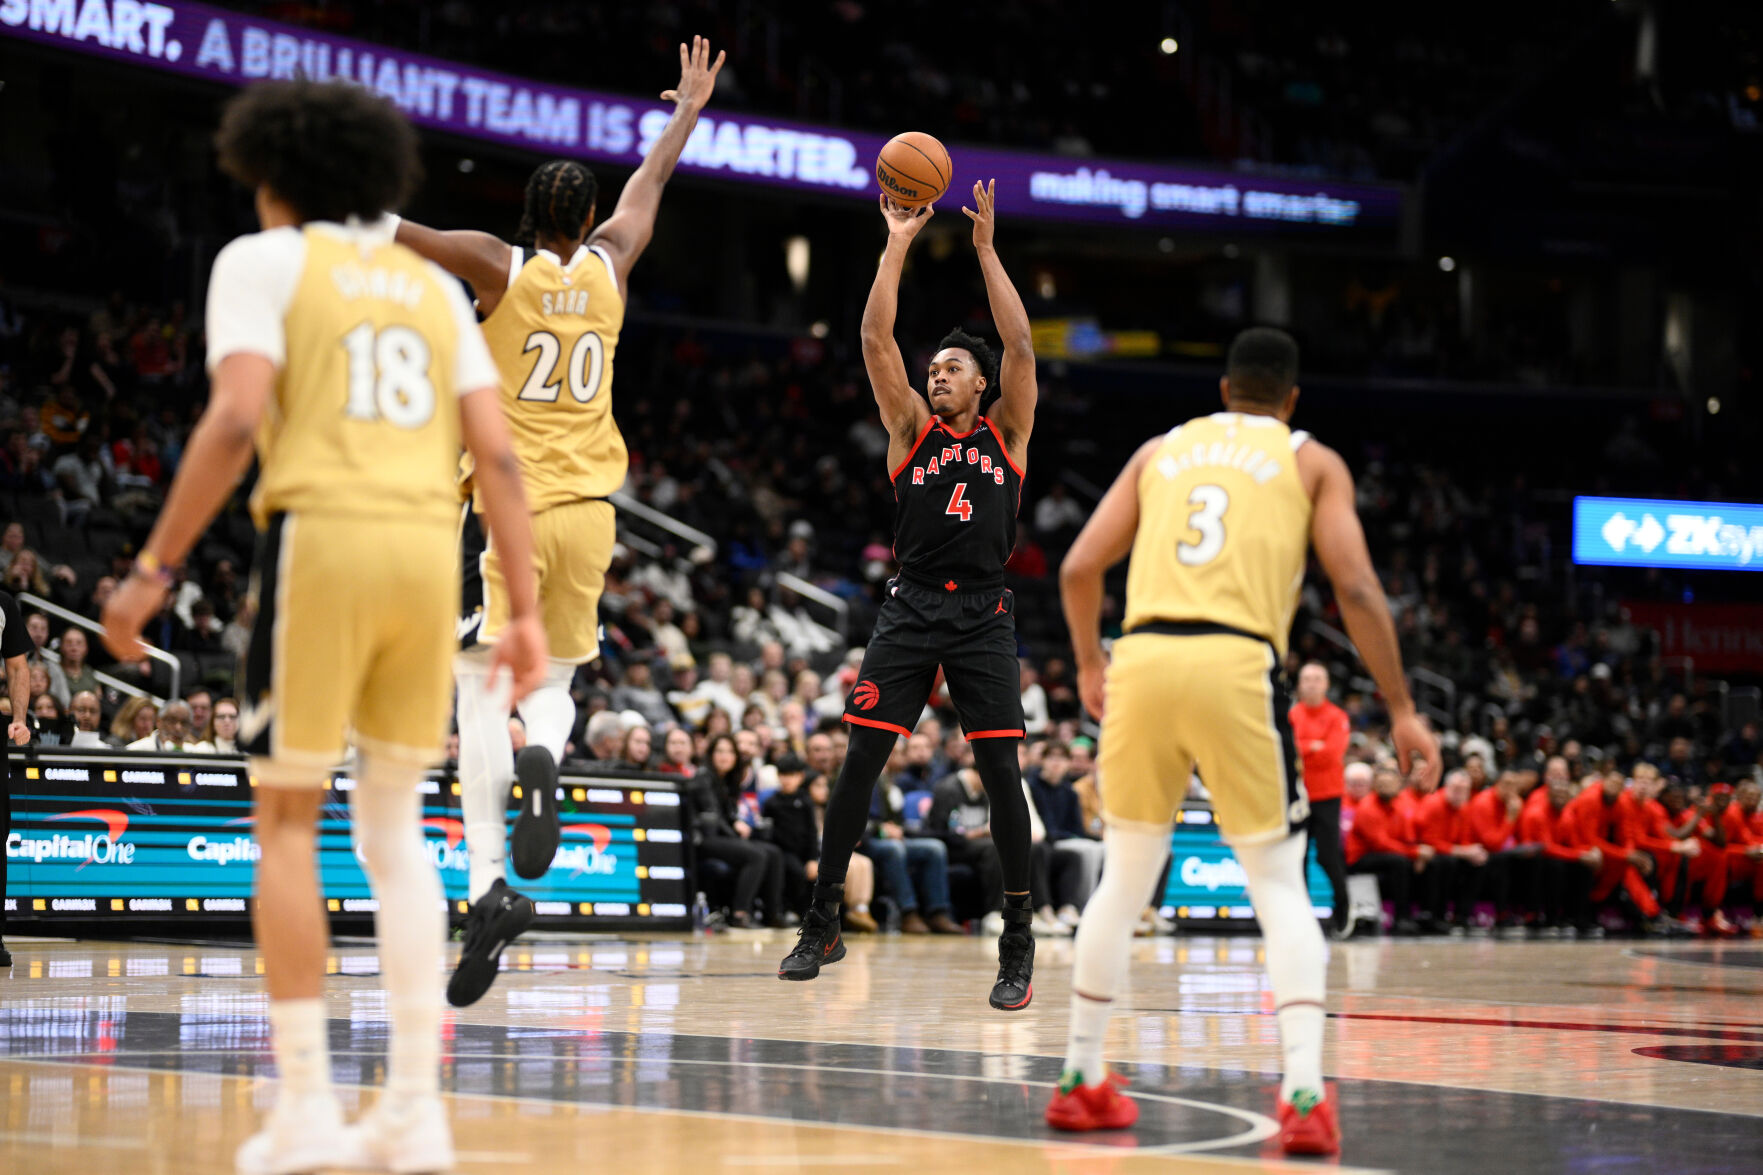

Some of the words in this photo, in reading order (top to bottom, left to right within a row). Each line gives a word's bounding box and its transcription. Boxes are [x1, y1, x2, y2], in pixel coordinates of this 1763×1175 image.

[0, 0, 182, 61] SMART.
[196, 18, 234, 73] A
[242, 27, 459, 121] BRILLIANT
[462, 76, 580, 147] TEAM
[588, 103, 634, 154] IS
[878, 165, 917, 198] Wilson
[542, 289, 589, 316] SARR
[341, 320, 436, 428] 18
[517, 330, 604, 403] 20
[912, 443, 1004, 485] RAPTORS
[945, 483, 972, 521] 4
[1176, 484, 1229, 567] 3
